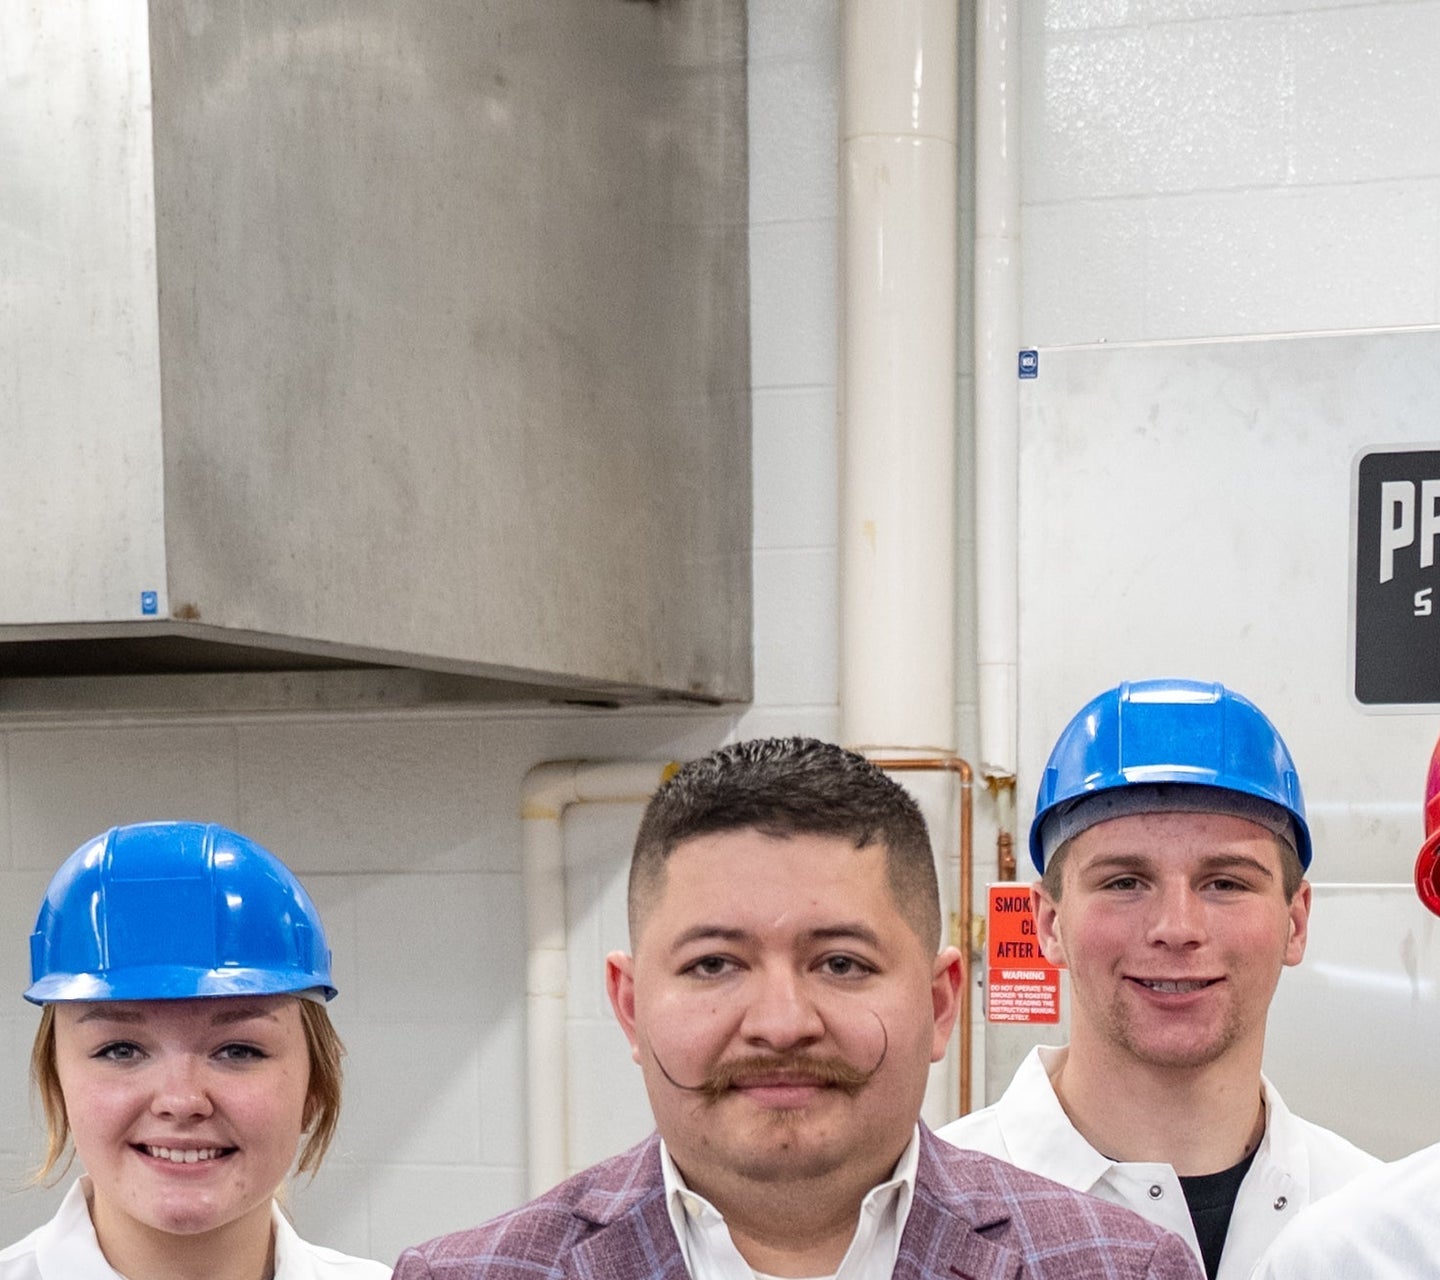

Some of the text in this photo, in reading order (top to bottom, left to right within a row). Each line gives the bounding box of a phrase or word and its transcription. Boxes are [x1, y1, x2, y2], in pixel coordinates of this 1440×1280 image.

[995, 897, 1033, 912] SMOK
[997, 941, 1033, 958] AFTER
[1002, 970, 1046, 980] WARNING
